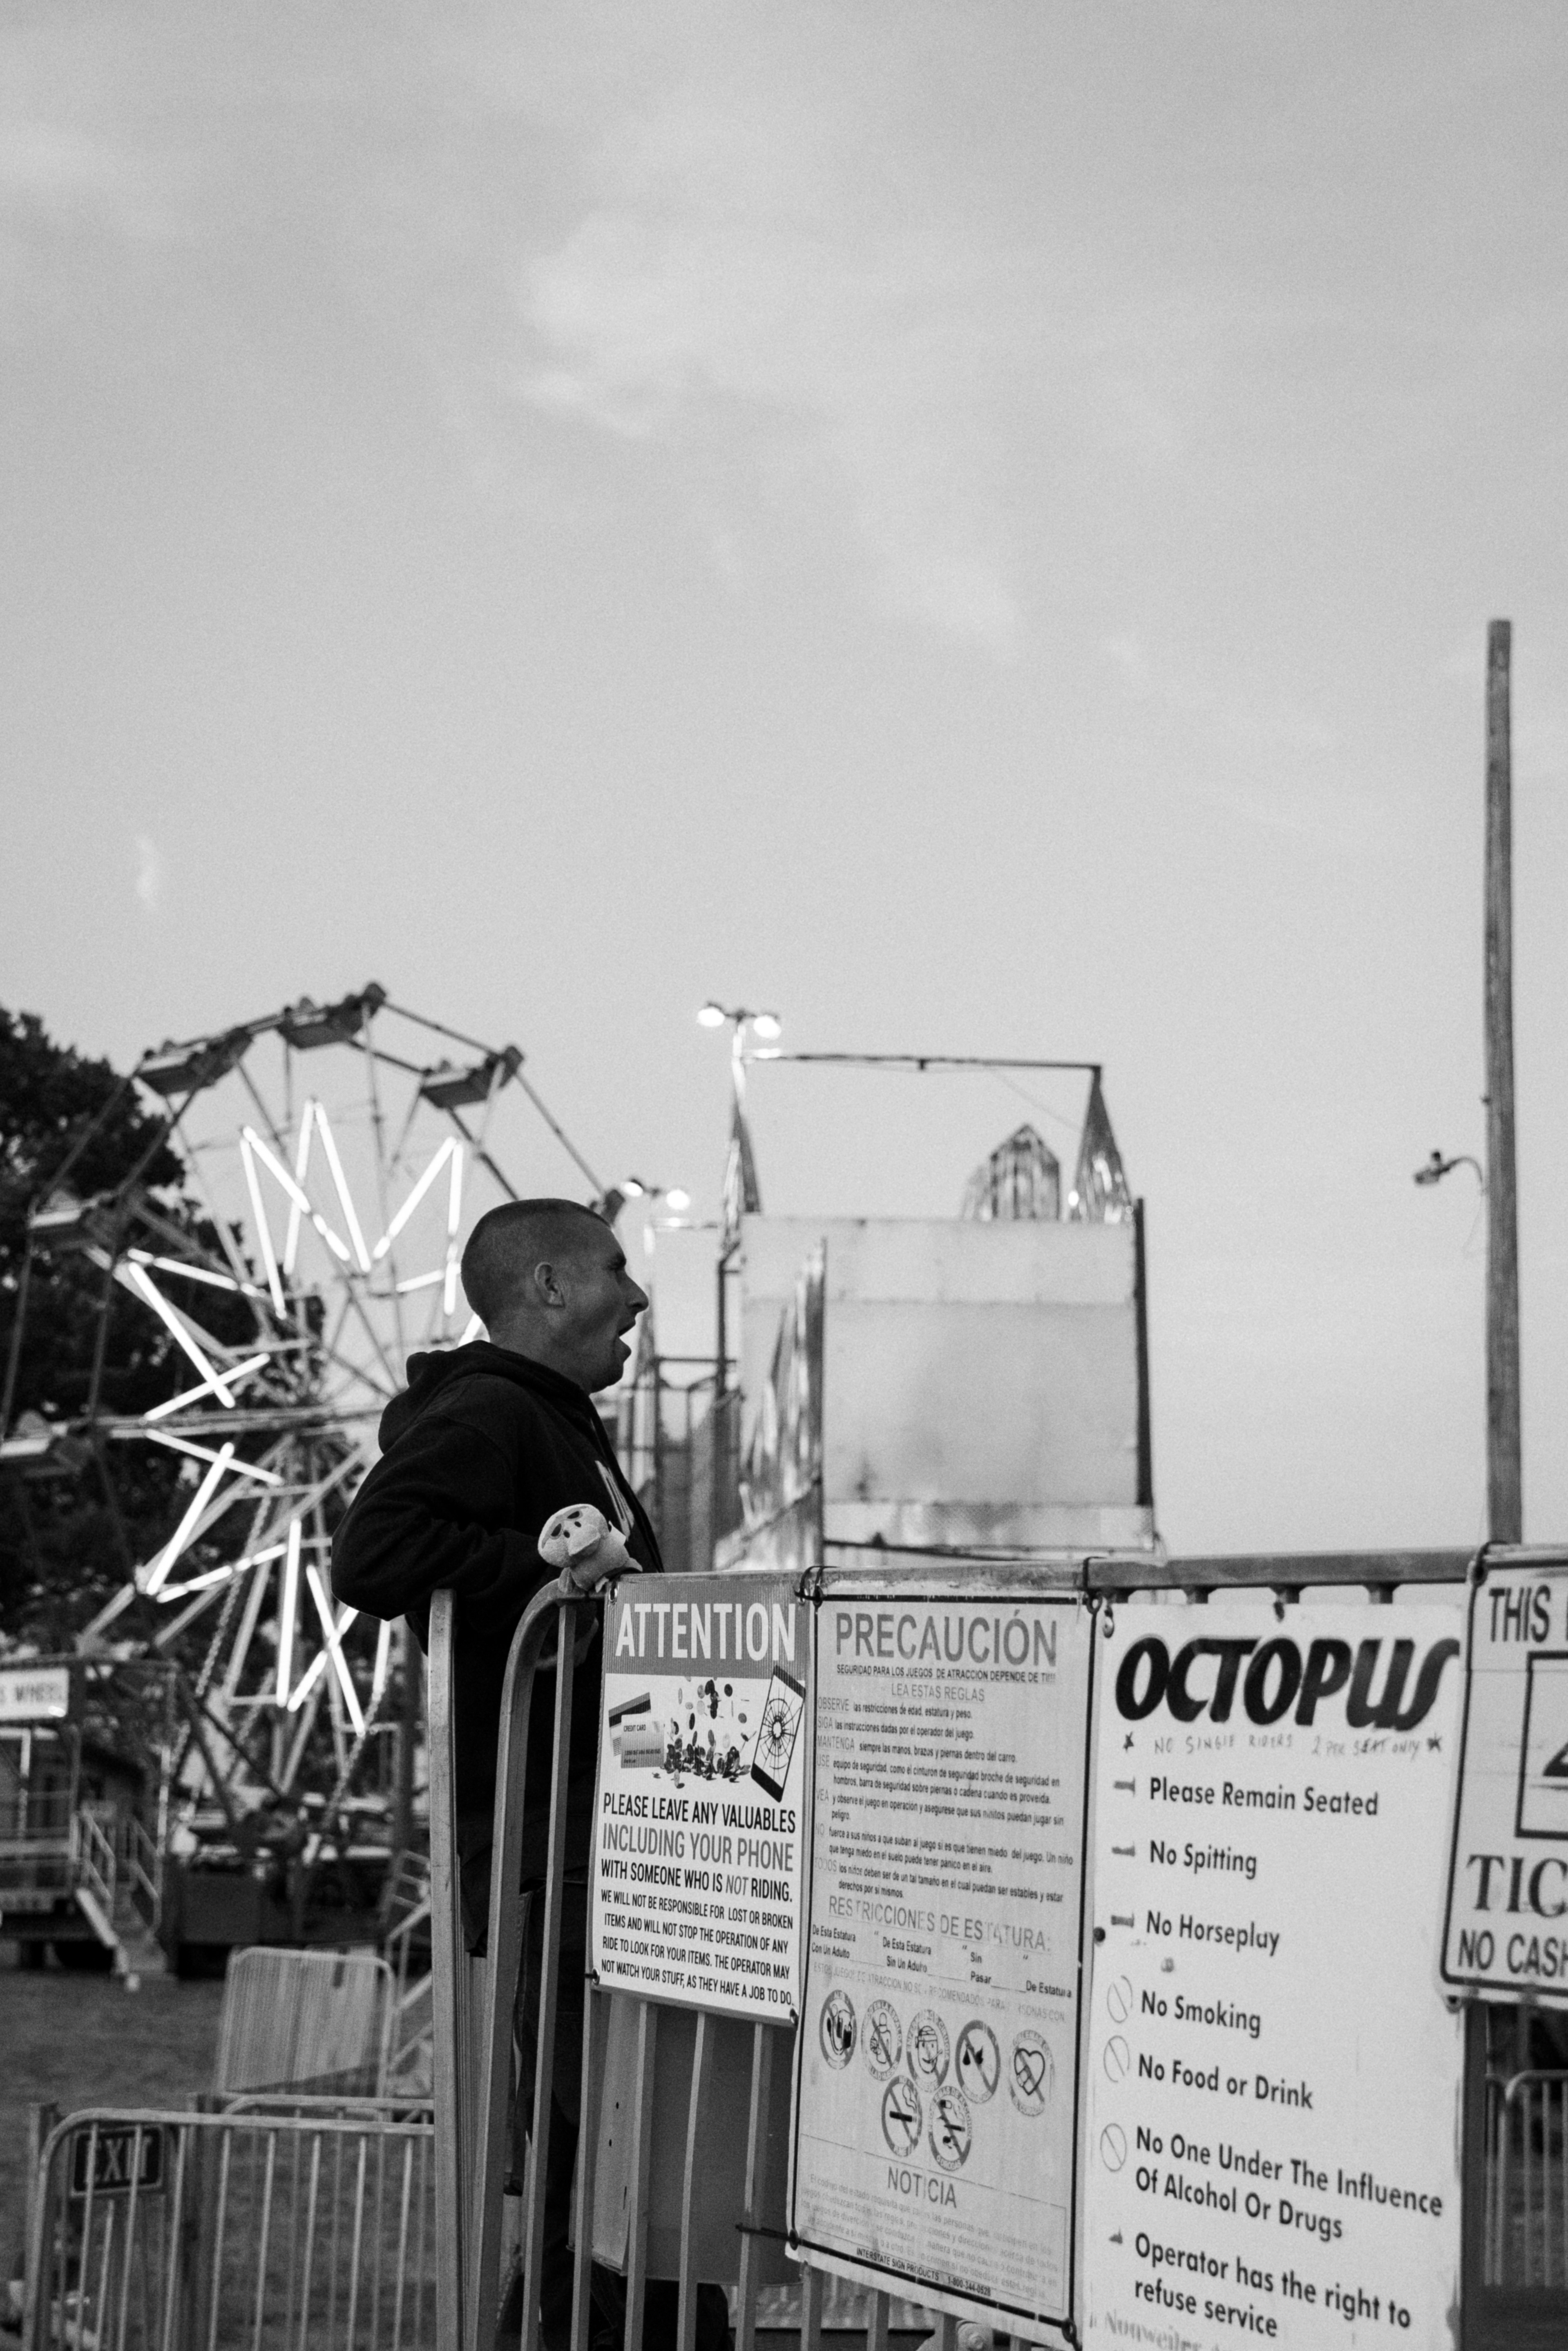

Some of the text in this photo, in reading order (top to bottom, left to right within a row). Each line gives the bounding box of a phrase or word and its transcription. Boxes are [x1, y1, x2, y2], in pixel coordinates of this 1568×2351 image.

[615, 1602, 796, 1662] ATTENTION
[1489, 1584, 1551, 1643] THIS
[836, 1609, 1057, 1667] PRECAUCIÓN
[837, 1664, 871, 1676] SEGURIDAD
[873, 1666, 890, 1675] PARA
[891, 1667, 904, 1677] LOS
[906, 1667, 932, 1678] JUEGOS
[936, 1668, 945, 1678] DE
[990, 1670, 1025, 1681] DEPENDE
[1028, 1672, 1038, 1682] DE
[891, 1683, 984, 1702] LEA ESTAS REGLAS
[1114, 1633, 1460, 1732] OCTOPUS
[818, 1696, 849, 1711] OBSERVE
[603, 1792, 795, 1833] PLEASE LEAVE ANY VALUABLES
[1150, 1777, 1378, 1815] Please Remain Seated
[603, 1823, 793, 1871] INCLUDING YOUR PHONE
[1150, 1840, 1256, 1879] No Spitting
[601, 1859, 792, 1902] WITH SOMEONE WHO IS NOT RIDING.
[601, 1889, 793, 1929] WE WILL NOT BE RESPONSIBLE FOR LOST OR BROKEN
[605, 1913, 788, 1953] ITEMS AND WILL NOT STOP THE OPERATION OF ANY
[811, 1942, 822, 1953] Con
[823, 1946, 830, 1955] Un
[812, 1924, 855, 1942] De Esta Estatura
[883, 1936, 931, 1955] De Esta Estatura
[1146, 1910, 1279, 1956] No Horseplay
[1458, 1929, 1495, 1970] NO
[603, 1936, 789, 1979] RIDE TO LOOK FOR YOUR ITEMS. THE OPERATOR MAY
[970, 1952, 982, 1963] Sin
[971, 1971, 992, 1984] Pasar
[602, 1959, 793, 2005] NOT WATCH YOUR STUFF, AS THEY HAVE A JOB TO DO.
[1141, 1990, 1260, 2038] No Smoking
[1139, 2054, 1312, 2109] No Food or Drink
[888, 2166, 956, 2208] NOTICIA
[1137, 2126, 1442, 2216] No One Under The Influence
[1136, 2167, 1342, 2241] Of Alcohol Or Drugs
[857, 2247, 890, 2265] INTERSTATE
[892, 2258, 905, 2271] SIGN
[906, 2263, 939, 2281] PRODUCTS
[1135, 2233, 1410, 2328] Operator has the right to
[1135, 2279, 1196, 2314] refuse
[1205, 2301, 1277, 2337] service
